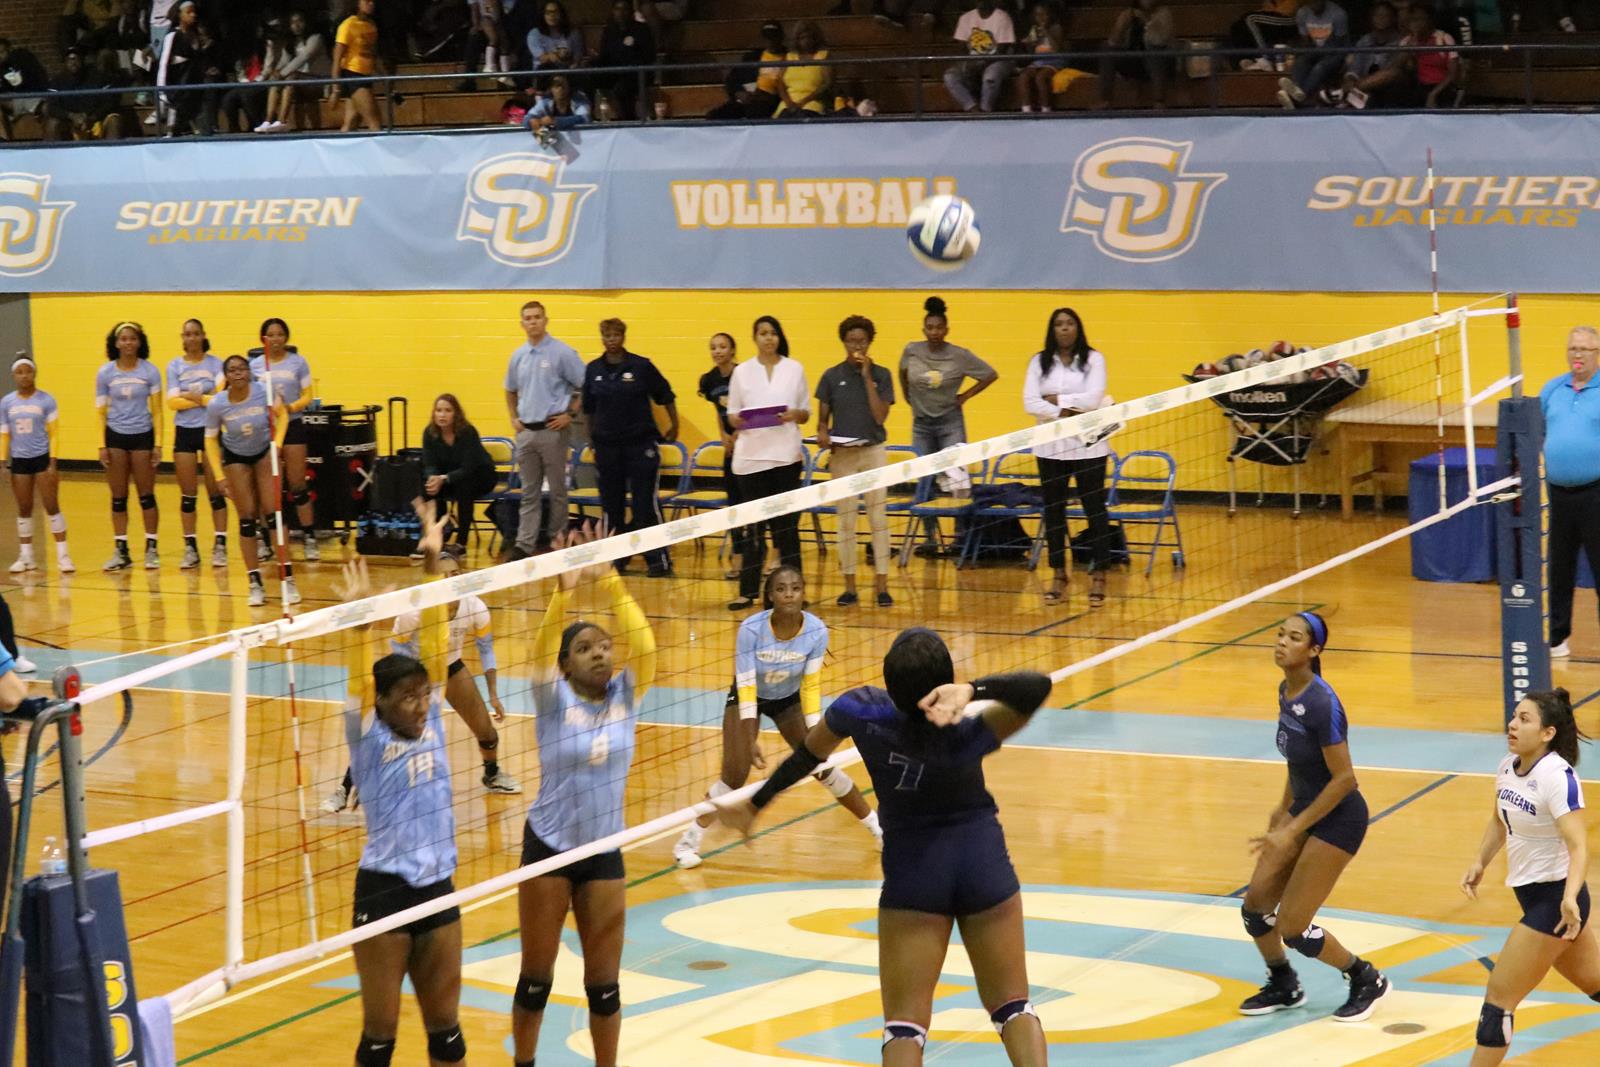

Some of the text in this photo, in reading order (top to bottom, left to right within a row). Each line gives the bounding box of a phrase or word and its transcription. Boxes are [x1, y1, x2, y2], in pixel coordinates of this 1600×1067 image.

[1060, 136, 1228, 262] SU
[1306, 174, 1600, 210] SOUTHER
[115, 196, 362, 231] SOUTHERN
[458, 152, 597, 268] SU
[1352, 207, 1582, 228] JAGUARS
[147, 225, 310, 245] JAGUARS
[888, 750, 926, 791] 7
[1500, 787, 1537, 817] ORLEANS
